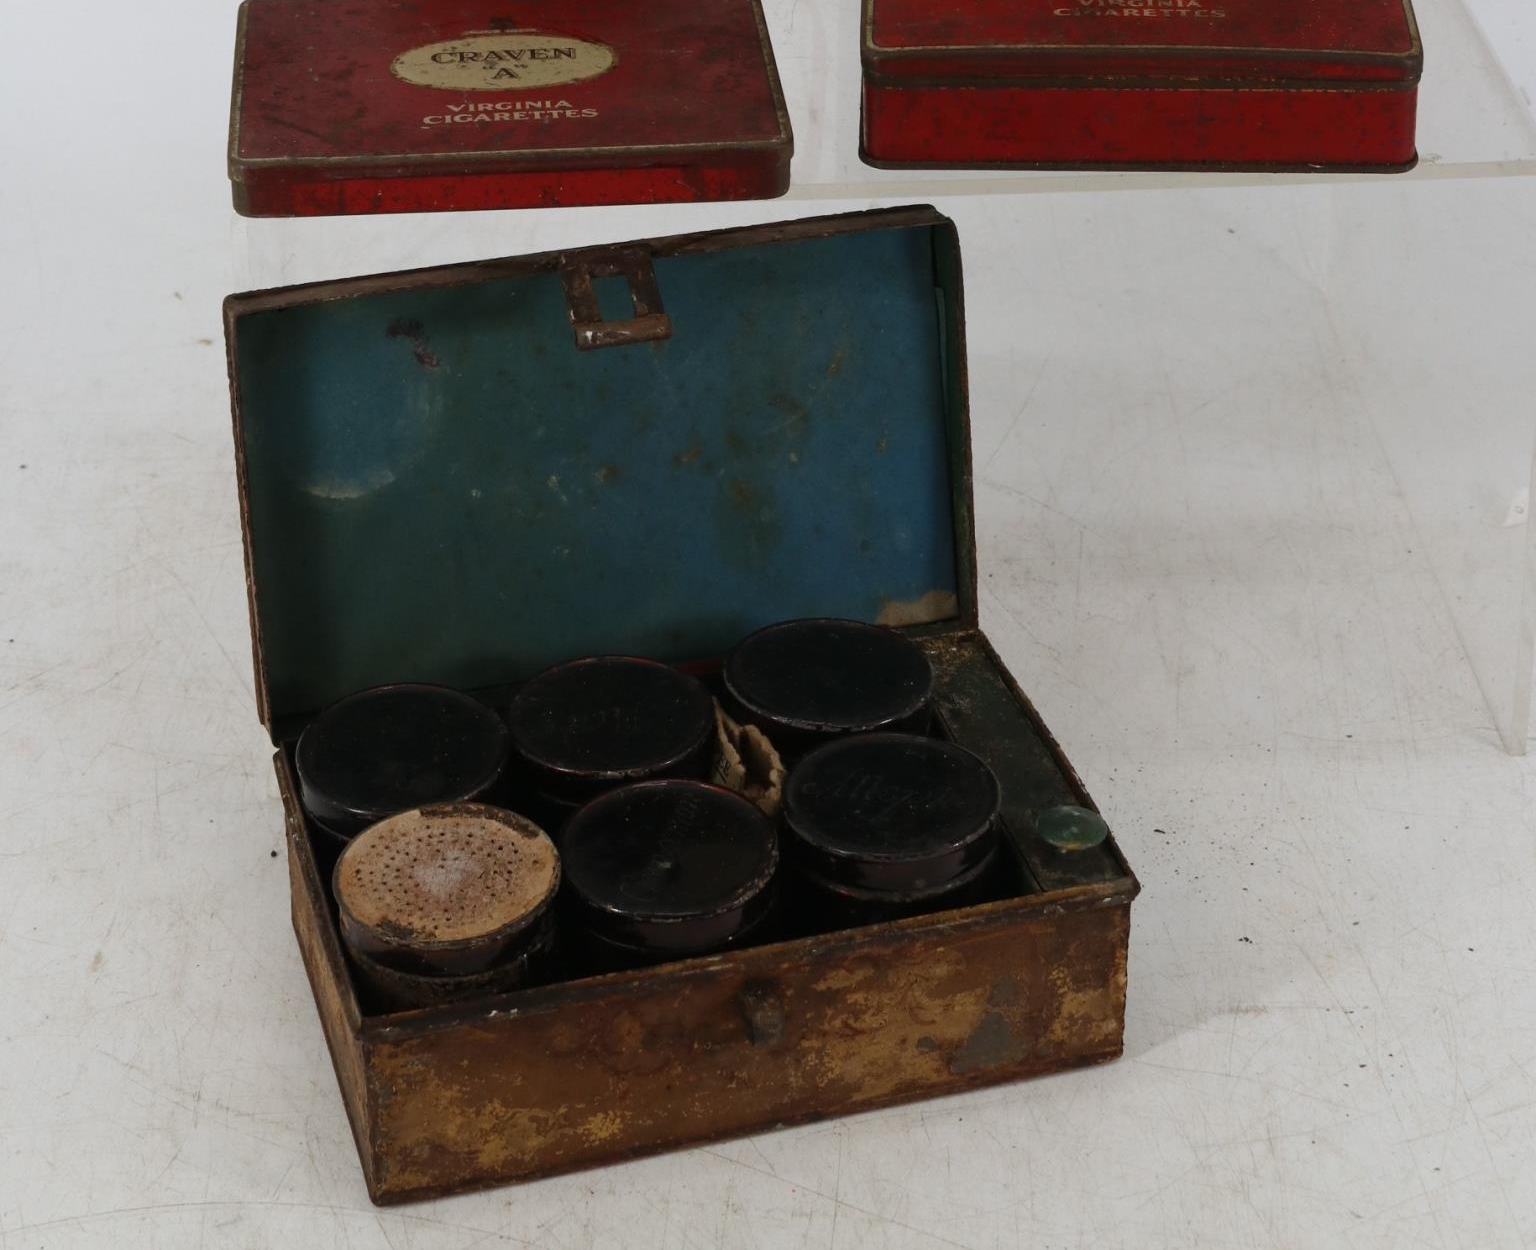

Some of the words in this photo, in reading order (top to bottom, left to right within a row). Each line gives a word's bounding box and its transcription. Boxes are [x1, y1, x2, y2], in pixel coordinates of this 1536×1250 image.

[430, 47, 577, 65] CRAVEN
[447, 100, 573, 113] VIRGINIA
[422, 108, 599, 125] CIGARETTES
